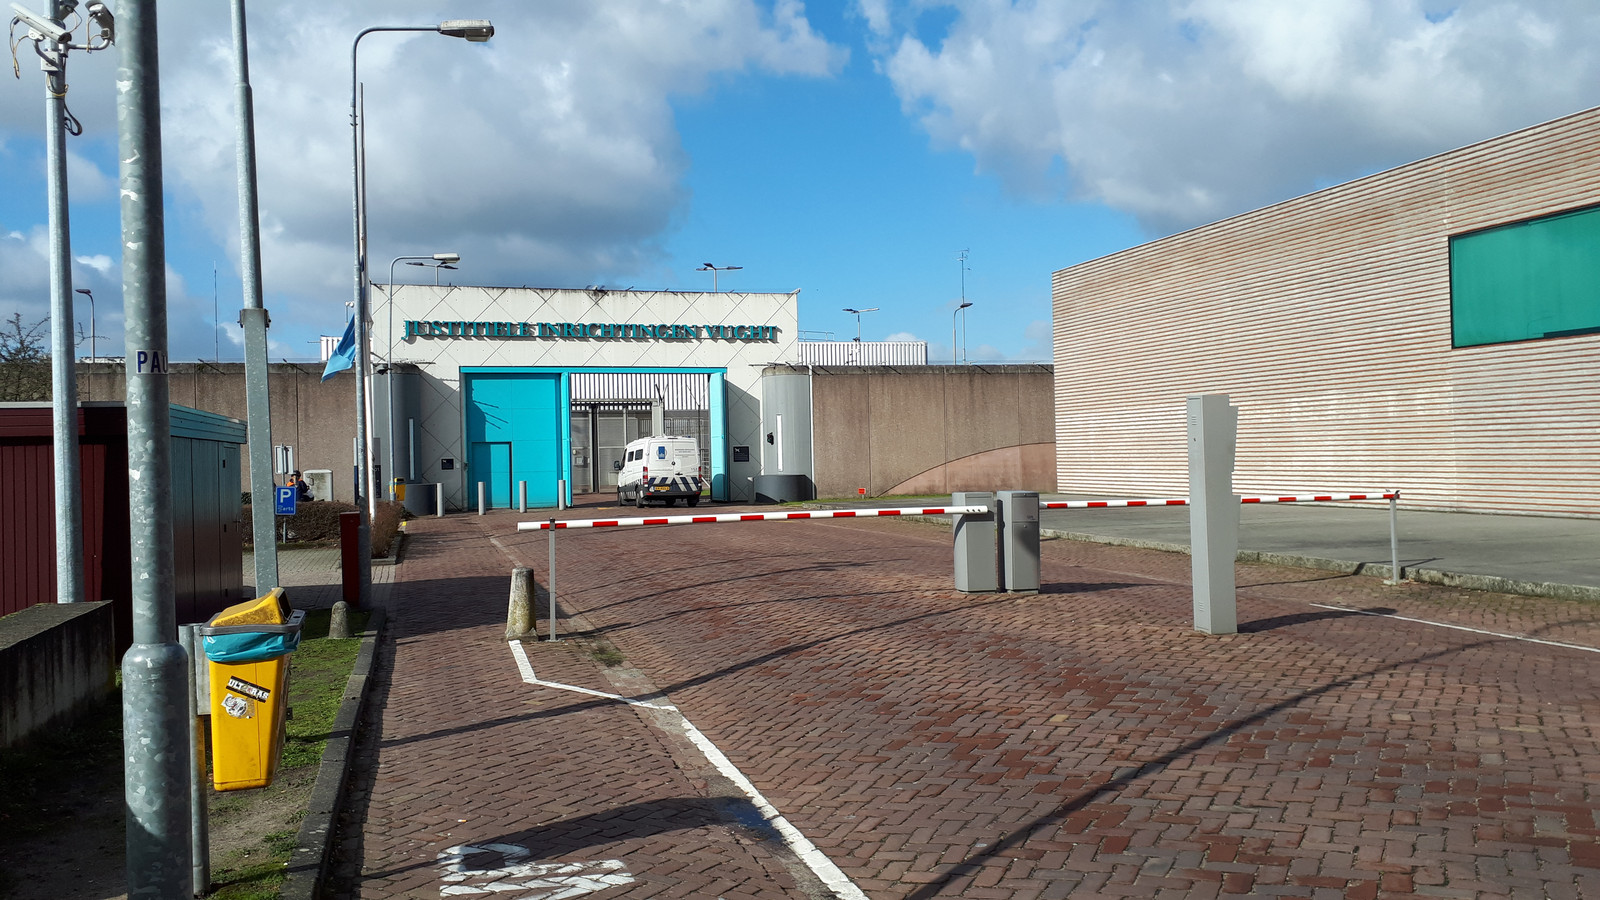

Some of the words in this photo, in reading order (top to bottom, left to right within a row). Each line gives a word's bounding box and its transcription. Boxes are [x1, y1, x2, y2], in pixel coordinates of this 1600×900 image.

[401, 320, 531, 340] JUSTITIELE
[537, 322, 697, 339] INRICHTINGEN
[704, 324, 777, 340] VUGHT
[280, 488, 292, 503] P
